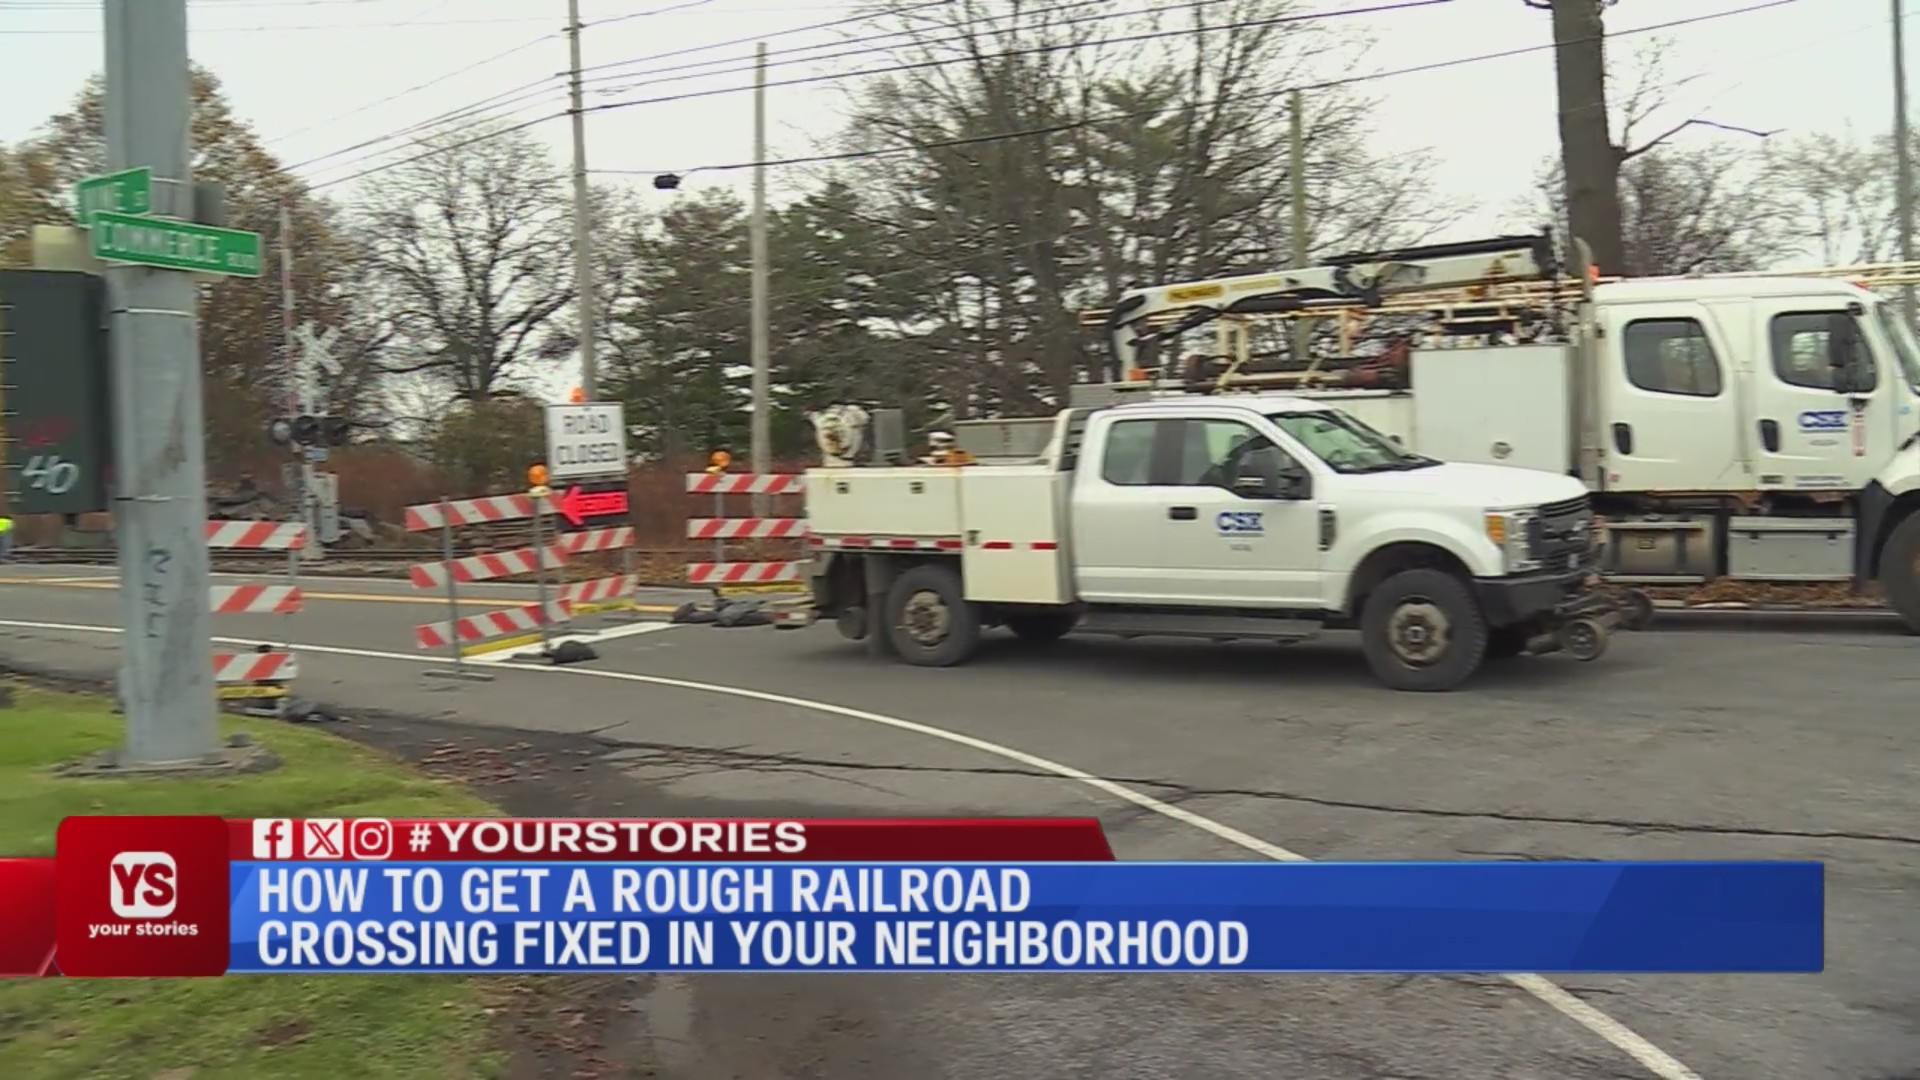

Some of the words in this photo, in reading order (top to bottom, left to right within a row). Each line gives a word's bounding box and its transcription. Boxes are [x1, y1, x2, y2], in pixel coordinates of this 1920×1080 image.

[96, 220, 221, 264] COMMERCE
[563, 414, 609, 435] ROAD
[1798, 410, 1848, 428] CSX
[557, 442, 619, 465] CLOSED
[1216, 512, 1264, 531] CSX
